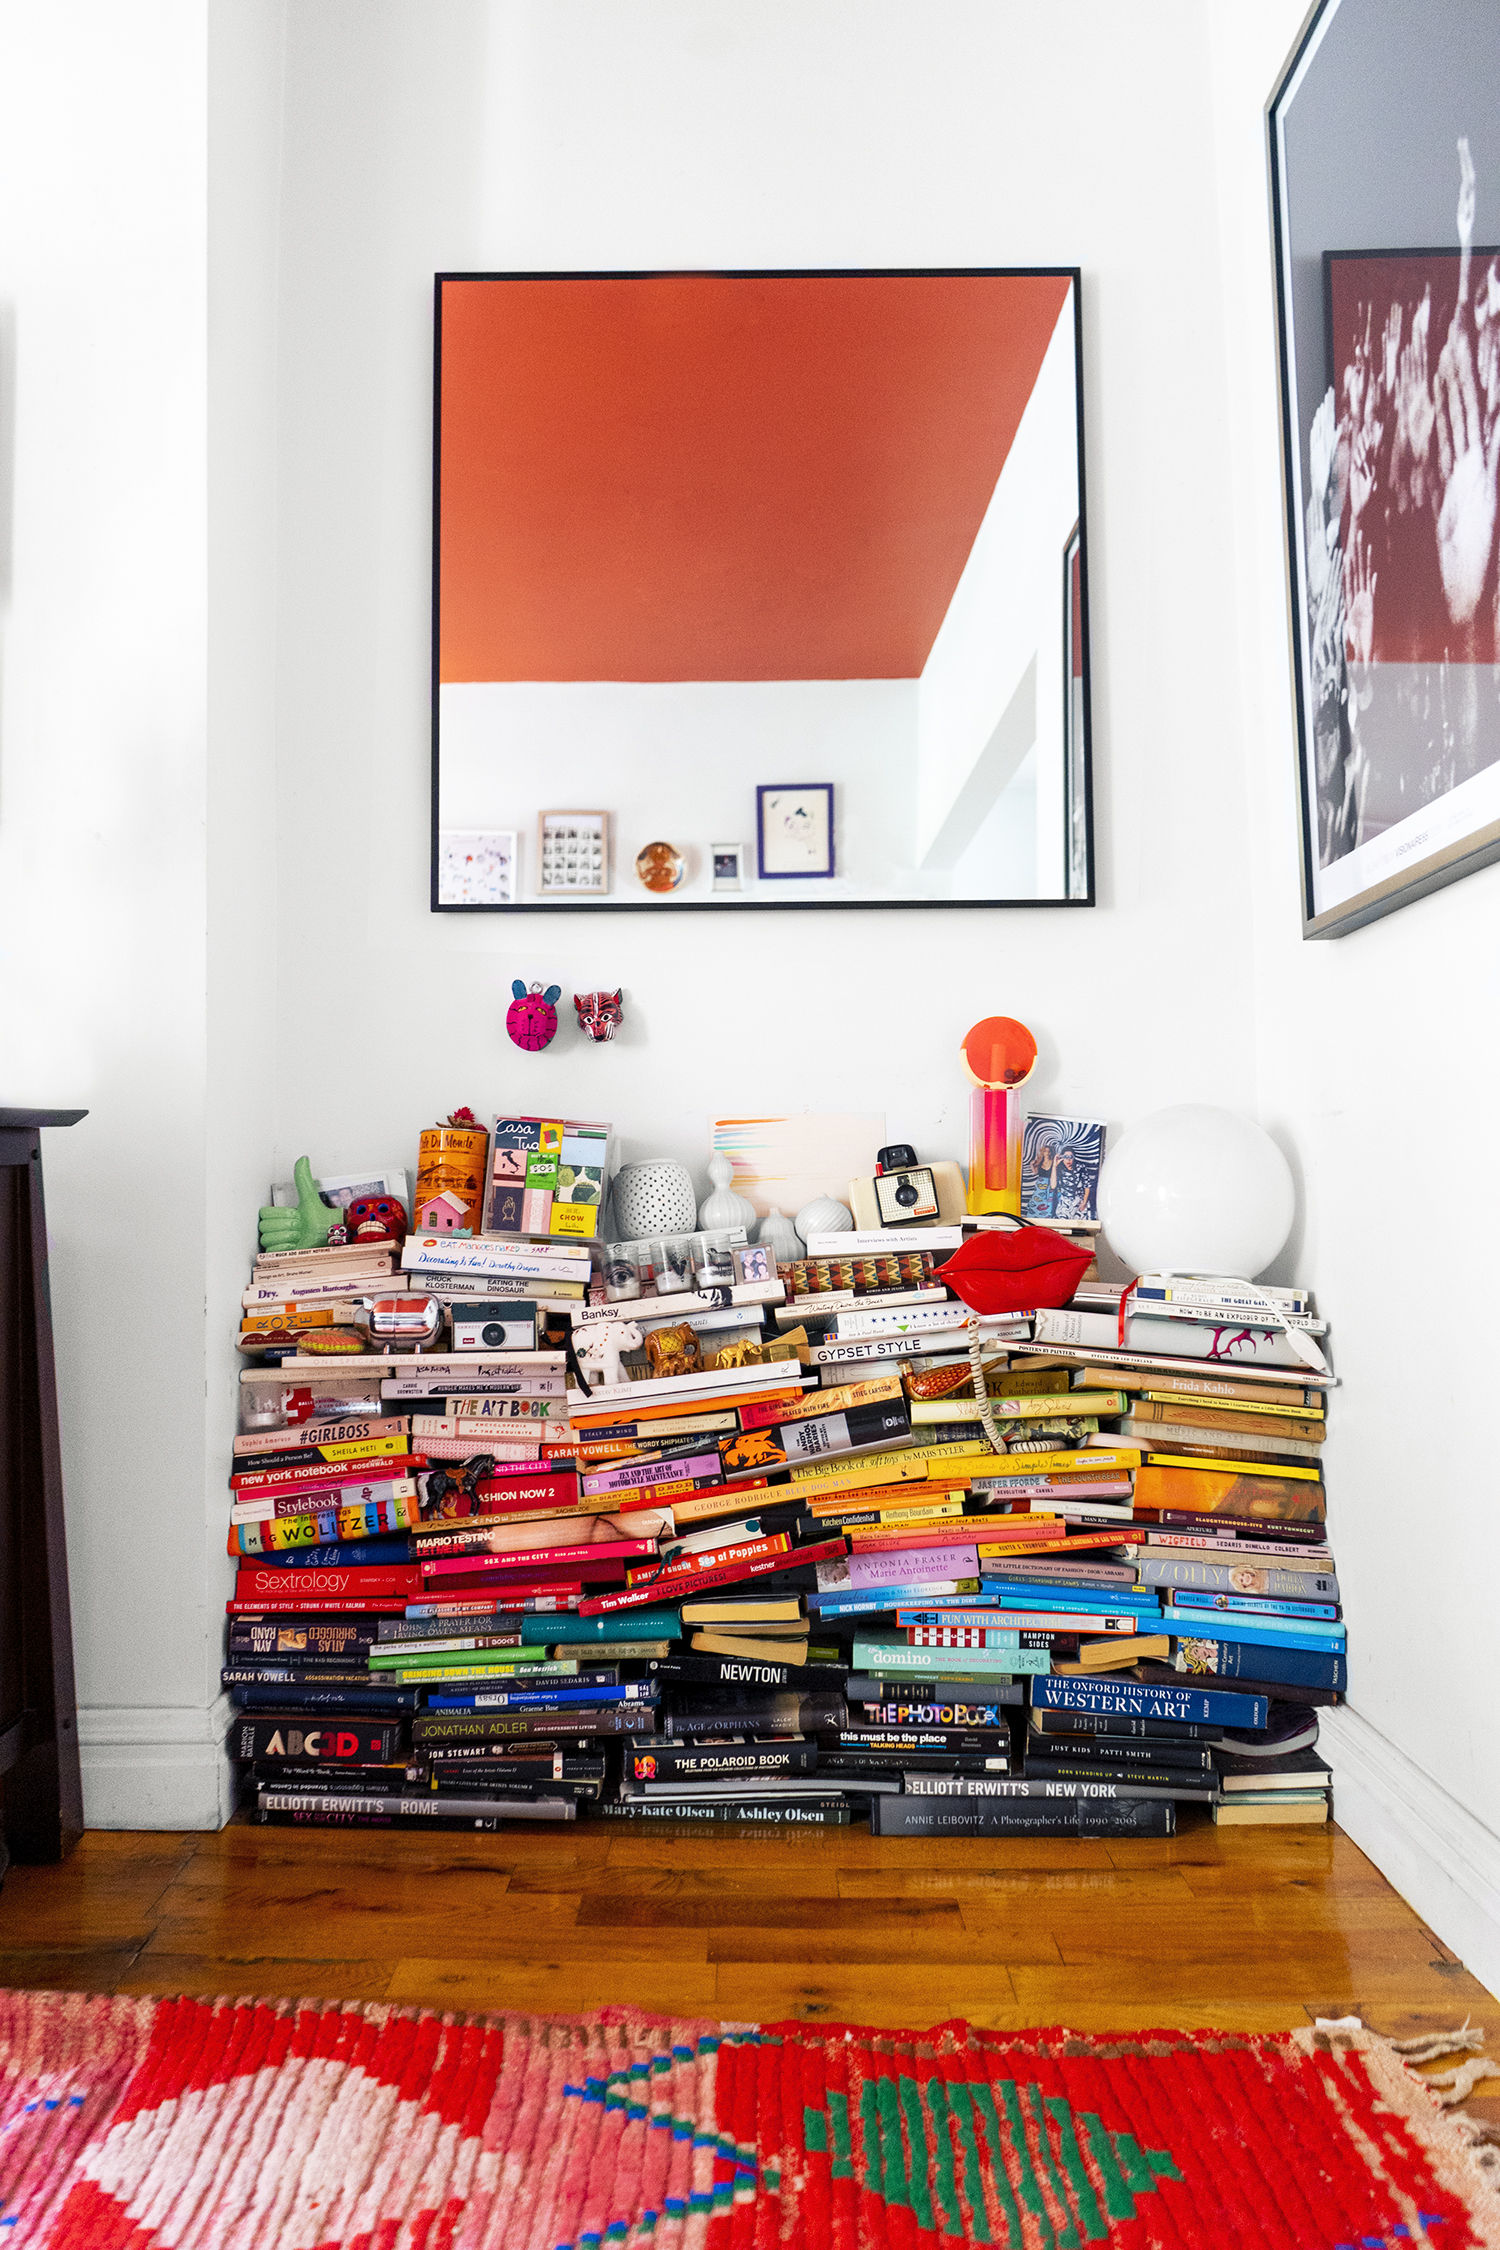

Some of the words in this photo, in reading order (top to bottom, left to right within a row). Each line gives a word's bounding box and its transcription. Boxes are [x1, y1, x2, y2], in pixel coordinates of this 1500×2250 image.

[496, 1120, 535, 1134] Casa
[512, 1136, 539, 1150] Tua
[418, 1252, 459, 1267] Decorating
[460, 1254, 466, 1265] Is
[467, 1255, 486, 1267] Fun!
[488, 1260, 516, 1271] Dorothy
[516, 1262, 540, 1273] Draper
[425, 1282, 474, 1290] KLOSTERMAN
[487, 1285, 524, 1293] DINOSAUR
[258, 1290, 279, 1299] Dry.
[582, 1308, 619, 1320] Banksy
[818, 1346, 872, 1361] GYPSET
[878, 1339, 921, 1354] STYLE
[853, 1390, 867, 1398] STIEG
[868, 1385, 892, 1395] LARSSON
[1173, 1379, 1199, 1389] Frida
[1203, 1382, 1235, 1394] Kahlo
[451, 1400, 478, 1415] THE
[482, 1400, 508, 1415] ART
[510, 1401, 551, 1417] BOOK
[783, 1409, 802, 1417] PLAYED
[802, 1405, 816, 1414] WITH
[818, 1403, 830, 1412] FIRE
[300, 1424, 369, 1444] #GIRLBOSS
[332, 1448, 358, 1456] SHEILA
[360, 1445, 376, 1453] HETI
[548, 1448, 579, 1458] SARAH
[582, 1443, 622, 1457] VOWELL
[637, 1440, 659, 1448] WORDY
[661, 1437, 694, 1446] SHIPMATES
[795, 1469, 813, 1478] The
[815, 1466, 830, 1477] Big
[832, 1462, 856, 1471] Book
[856, 1460, 866, 1468] of
[869, 1457, 884, 1469] soft
[885, 1455, 899, 1466] toys
[904, 1453, 911, 1462] by
[913, 1450, 937, 1459] MABS
[939, 1445, 965, 1455] TYLER
[241, 1476, 264, 1485] new
[267, 1471, 292, 1482] york
[295, 1464, 348, 1479] notebook
[977, 1479, 1008, 1490] JASPER
[1010, 1477, 1040, 1486] FFORDE
[1057, 1475, 1071, 1484] THE
[1073, 1474, 1100, 1483] FOURTH
[1102, 1472, 1120, 1481] BEAR
[478, 1491, 517, 1502] ASHION
[520, 1489, 546, 1499] NOW
[549, 1488, 555, 1497] 2
[694, 1500, 731, 1512] GEORGE
[735, 1490, 782, 1505] RODRIGUE
[786, 1485, 806, 1495] BLUE
[811, 1482, 829, 1491] DOG
[832, 1479, 851, 1488] MAN
[277, 1494, 339, 1515] Stylebook
[822, 1518, 842, 1527] Kitchen
[843, 1513, 875, 1525] Confidential
[885, 1510, 908, 1520] Anthony
[910, 1508, 934, 1517] Bourdain
[248, 1534, 277, 1545] MEG
[283, 1514, 389, 1541] WOLITZER
[883, 1522, 909, 1530] KALMAN
[1285, 1526, 1314, 1534] VONNEGUT
[417, 1537, 450, 1548] MARIO
[452, 1532, 495, 1545] TESTINO
[1159, 1535, 1207, 1547] WIGFIELD
[484, 1557, 499, 1565] SEX
[531, 1552, 549, 1560] CITY
[698, 1553, 716, 1566] Sea
[718, 1553, 727, 1561] of
[730, 1544, 768, 1559] Poppies
[856, 1559, 909, 1571] ANTONIA
[915, 1554, 956, 1564] FRASER
[870, 1567, 897, 1578] Marie
[899, 1564, 948, 1575] Antoinette
[255, 1571, 349, 1591] Sextrology
[601, 1598, 617, 1609] Tim
[619, 1593, 649, 1606] Walker
[661, 1582, 683, 1595] LOVE
[685, 1573, 726, 1588] PICTURES!
[750, 1561, 775, 1572] kestner
[839, 1604, 853, 1612] NICK
[854, 1602, 876, 1611] HORNBY
[942, 1615, 961, 1624] FUN
[964, 1615, 985, 1624] WITH
[988, 1616, 1063, 1627] ARCHITECTURE
[251, 1627, 277, 1640] RAND
[309, 1627, 357, 1640] SHRUGGED
[1023, 1632, 1055, 1640] HAMPTON
[253, 1640, 270, 1652] AYN
[318, 1640, 345, 1652] ATLAS
[1029, 1640, 1049, 1648] SIDES
[873, 1651, 931, 1665] domino
[223, 1672, 254, 1681] SARAH
[257, 1672, 296, 1682] VOWELL
[720, 1663, 781, 1683] NEWTON
[1045, 1679, 1070, 1689] THE
[1073, 1681, 1120, 1694] OXFORD
[1123, 1686, 1173, 1700] HISTORY
[1176, 1692, 1192, 1701] OF
[1045, 1690, 1142, 1714] WESTERN
[1150, 1702, 1191, 1718] ART
[421, 1725, 484, 1737] JONATHAN
[489, 1722, 527, 1734] ADLER
[265, 1729, 359, 1757] ABC3D
[840, 1732, 858, 1741] this
[860, 1733, 885, 1742] must
[887, 1733, 900, 1742] be
[901, 1733, 917, 1742] the
[919, 1733, 947, 1744] place
[675, 1758, 697, 1769] THE
[700, 1755, 755, 1768] POLAROID
[759, 1753, 790, 1765] BOOK
[912, 1781, 963, 1795] ELLIOTT
[968, 1782, 1029, 1797] ERWITT'S
[1046, 1783, 1076, 1797] NEW
[1081, 1784, 1116, 1798] YORK
[266, 1796, 318, 1810] ELLIOTT
[322, 1799, 384, 1813] ERWITT'S
[401, 1801, 439, 1815] ROME
[602, 1806, 673, 1818] Mary-Kate
[676, 1807, 714, 1817] Olsen
[737, 1807, 782, 1822] Ashley
[785, 1808, 825, 1820] Olsen
[905, 1816, 934, 1825] ANNIE
[938, 1816, 984, 1825] LEIBOVITZ
[991, 1816, 998, 1824] A
[1001, 1816, 1062, 1827] Photographer's
[1064, 1816, 1079, 1825] Life
[1115, 1817, 1137, 1825] 2005
